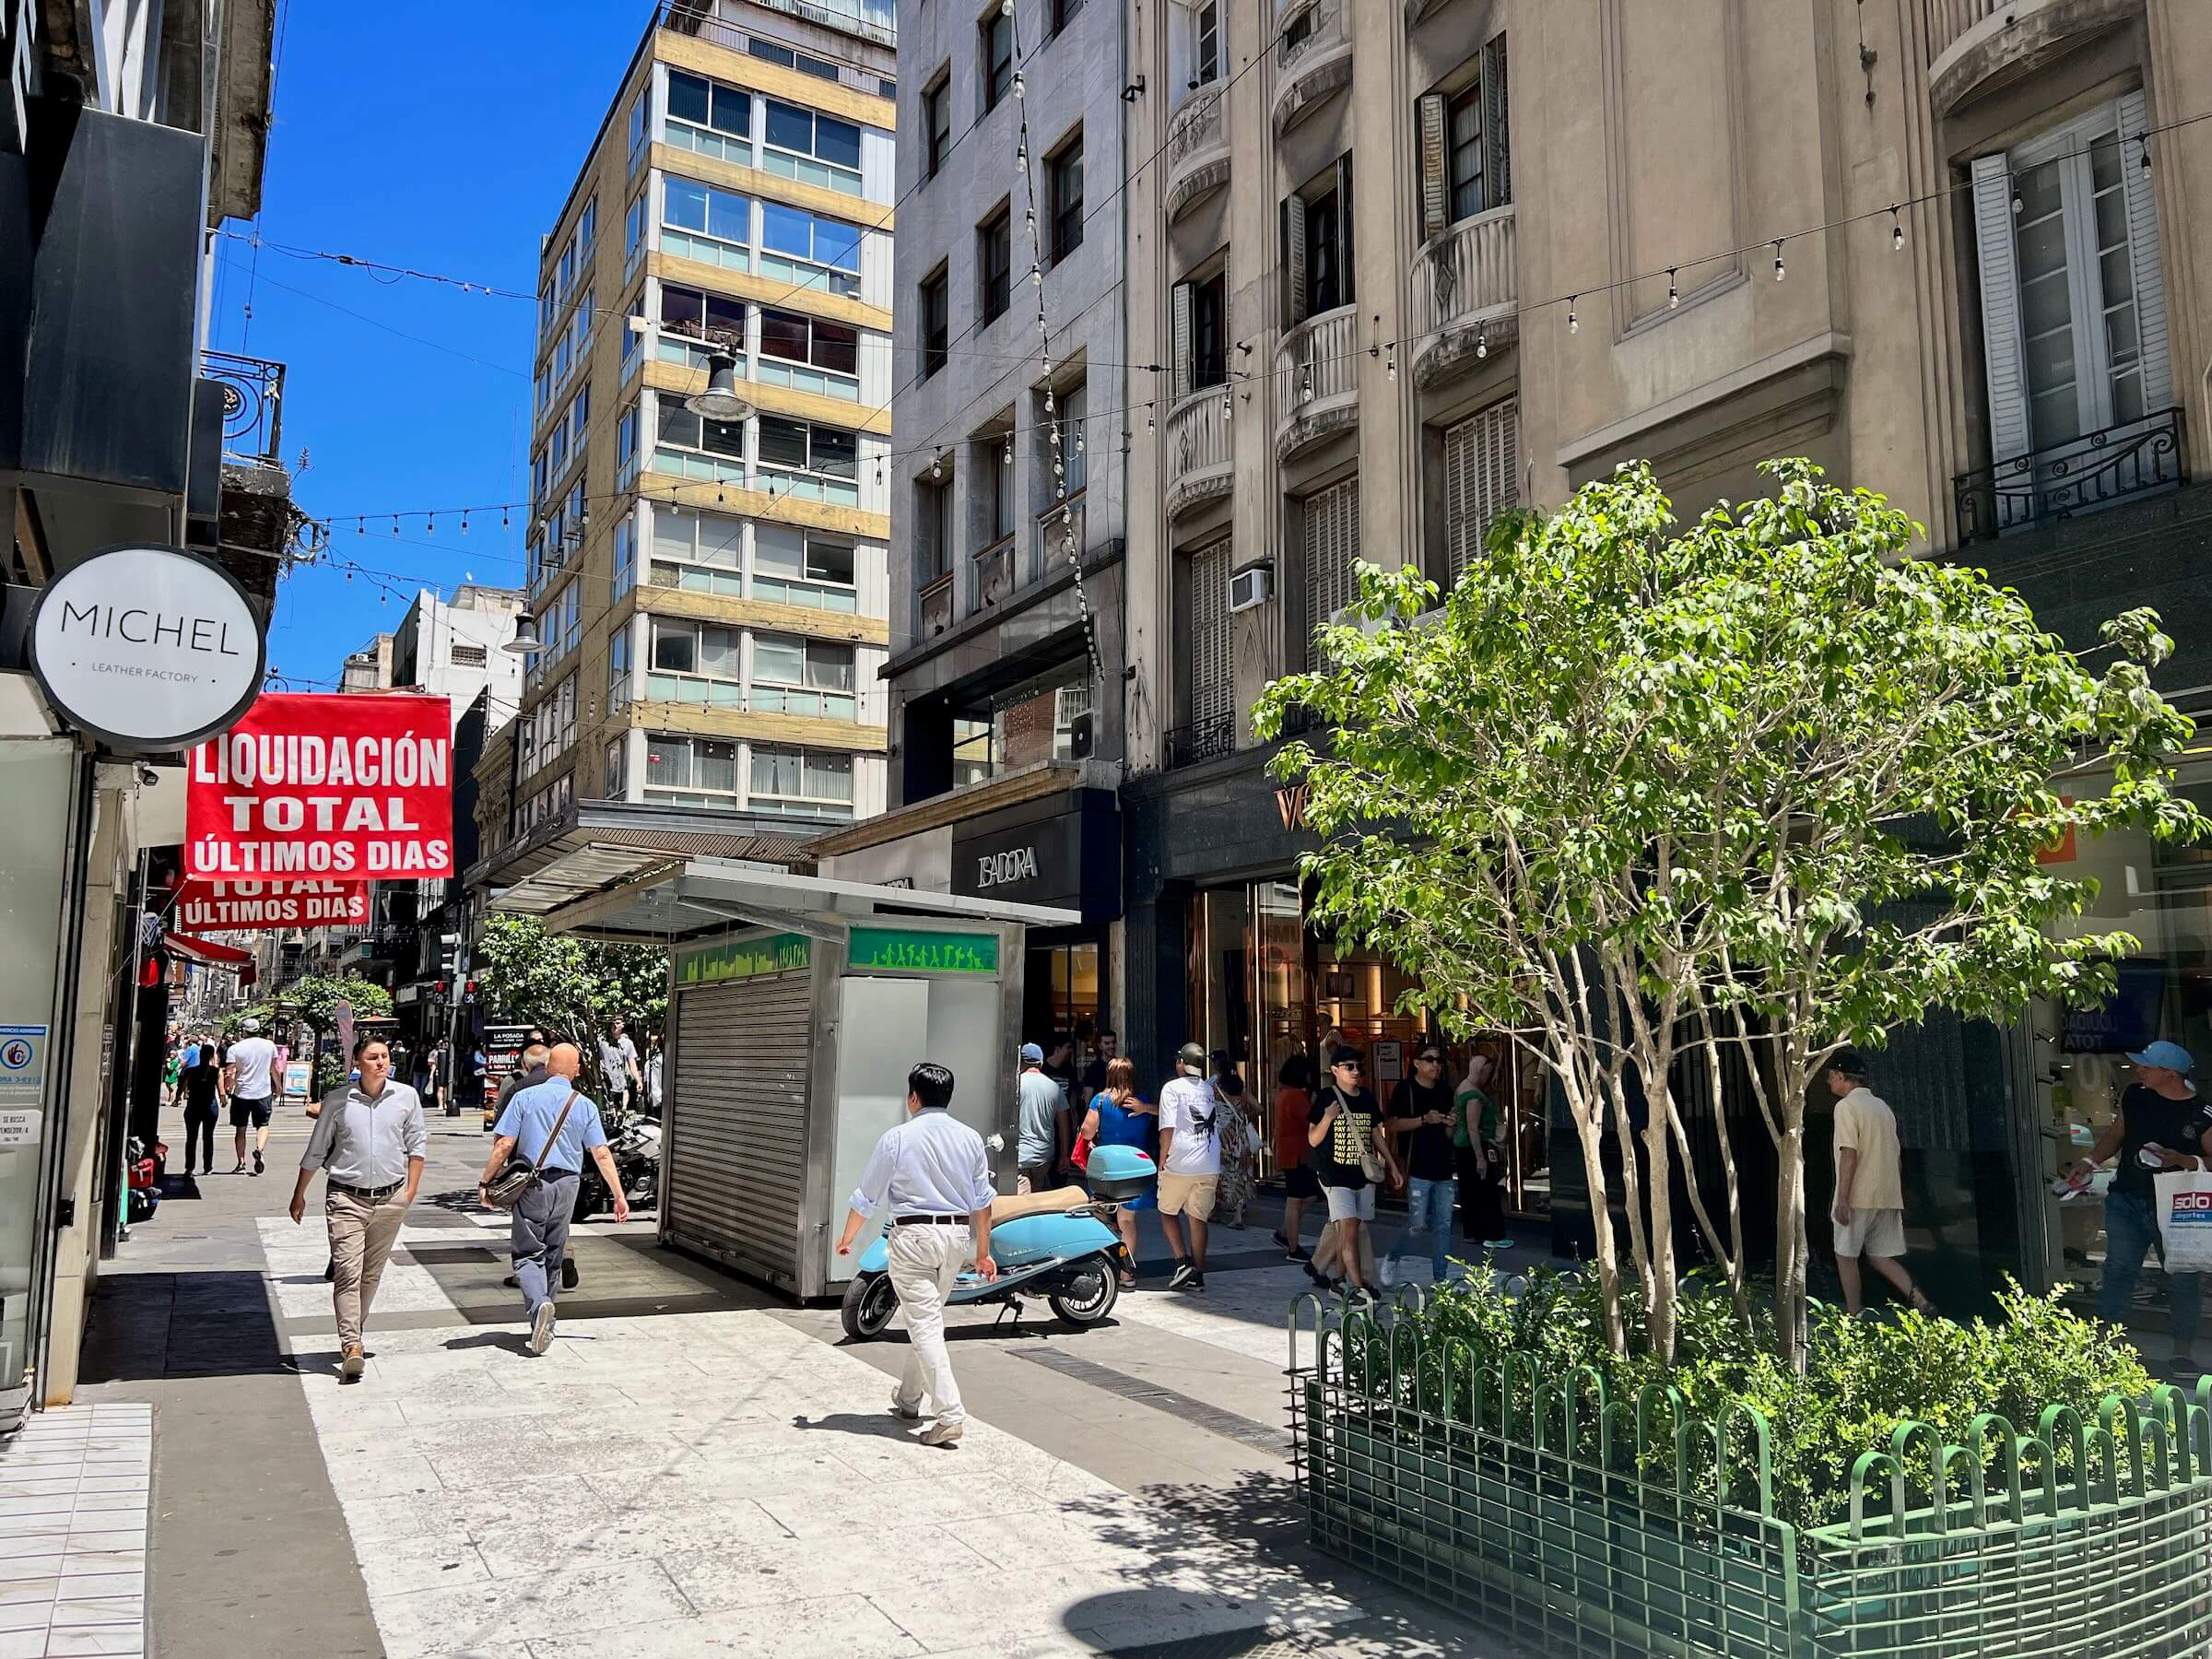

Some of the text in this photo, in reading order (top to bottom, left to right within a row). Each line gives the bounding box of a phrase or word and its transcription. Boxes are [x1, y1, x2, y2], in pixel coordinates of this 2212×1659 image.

[61, 600, 239, 655] MICHEL
[92, 663, 198, 684] LEATHER FACTORY
[194, 731, 446, 788] LIQUIDACIÓN
[223, 796, 419, 832] TOTAL
[194, 834, 449, 873] ÚLTIMOS DIAS
[978, 846, 1038, 888] ISADORA
[185, 895, 365, 924] ÚLTIMOS DIAS
[2174, 1193, 2210, 1209] solo
